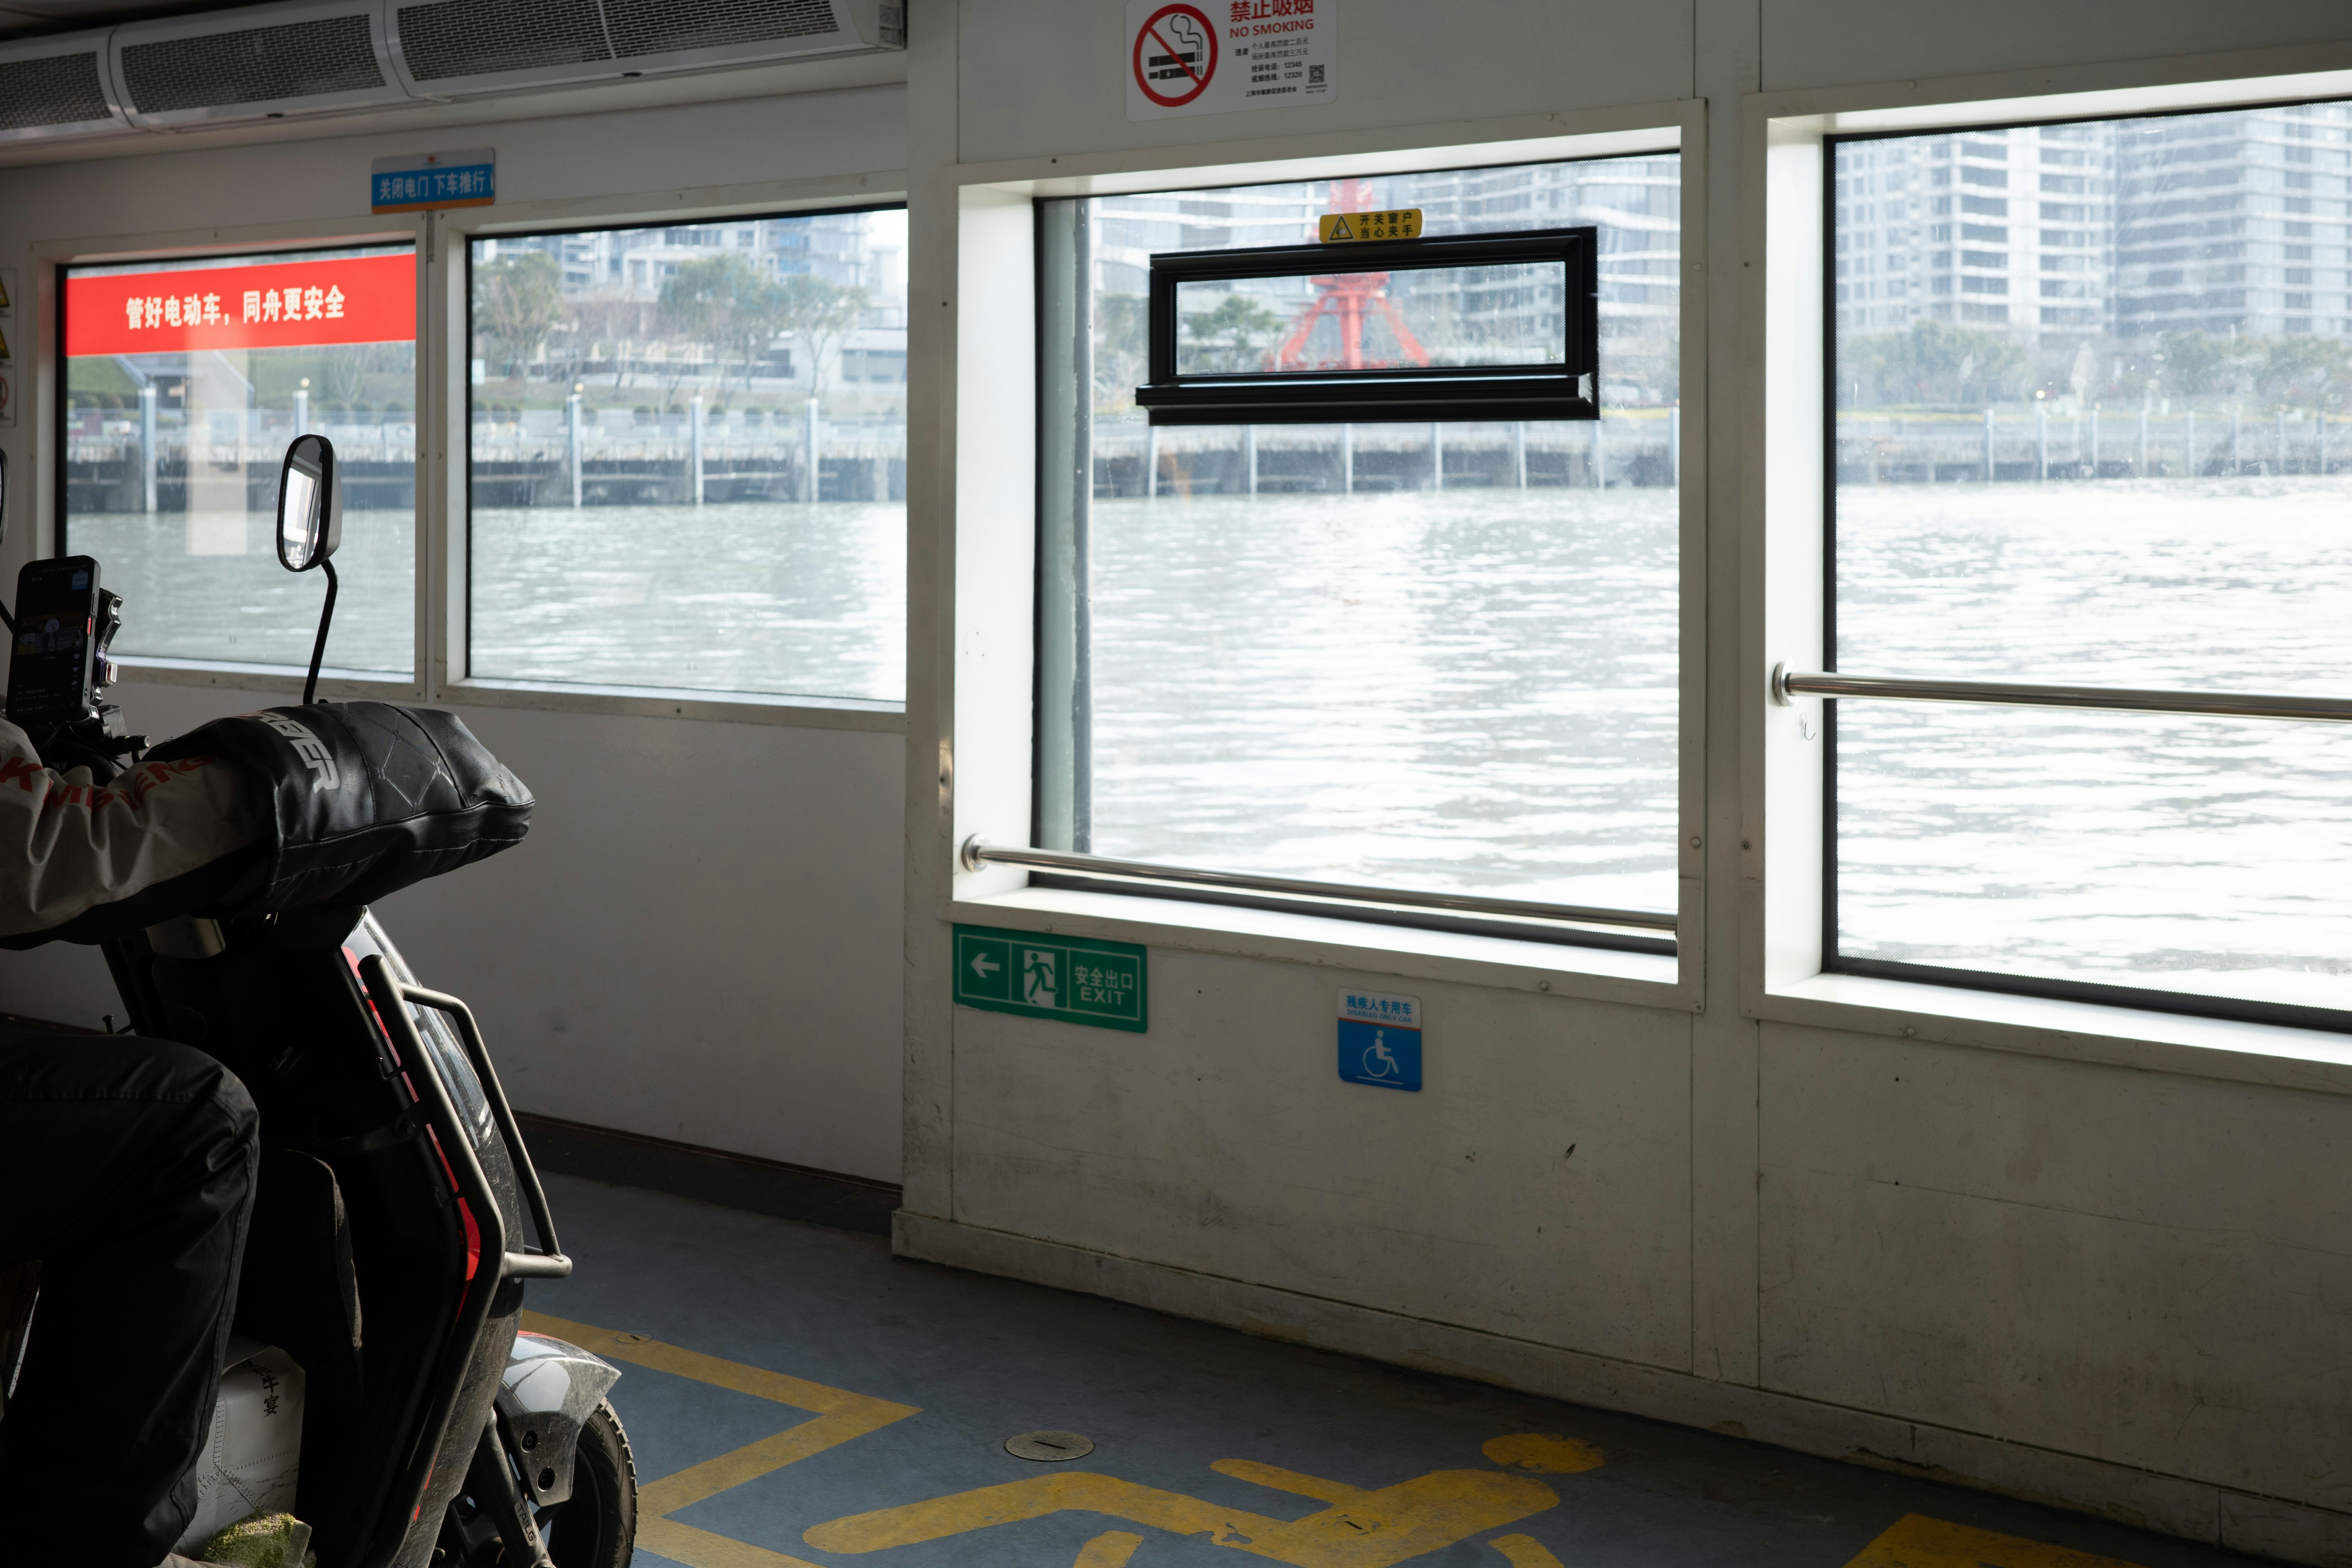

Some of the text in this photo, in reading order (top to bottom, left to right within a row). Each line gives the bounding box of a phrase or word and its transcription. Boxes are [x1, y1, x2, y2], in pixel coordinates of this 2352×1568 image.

[1230, 0, 1313, 22] 禁止吸烟
[1230, 19, 1314, 38] NO SMOKING
[379, 170, 485, 201] 关闭电门 下车推行
[1359, 211, 1412, 225] 开关窗户
[1360, 225, 1413, 238] 当心夹手
[1074, 965, 1133, 990] 安全出口
[1080, 987, 1125, 1005] EXIT
[1346, 995, 1412, 1016] 残疾人专用车
[1347, 1010, 1377, 1018] DISABLED
[517, 1503, 536, 1542] TAILG
